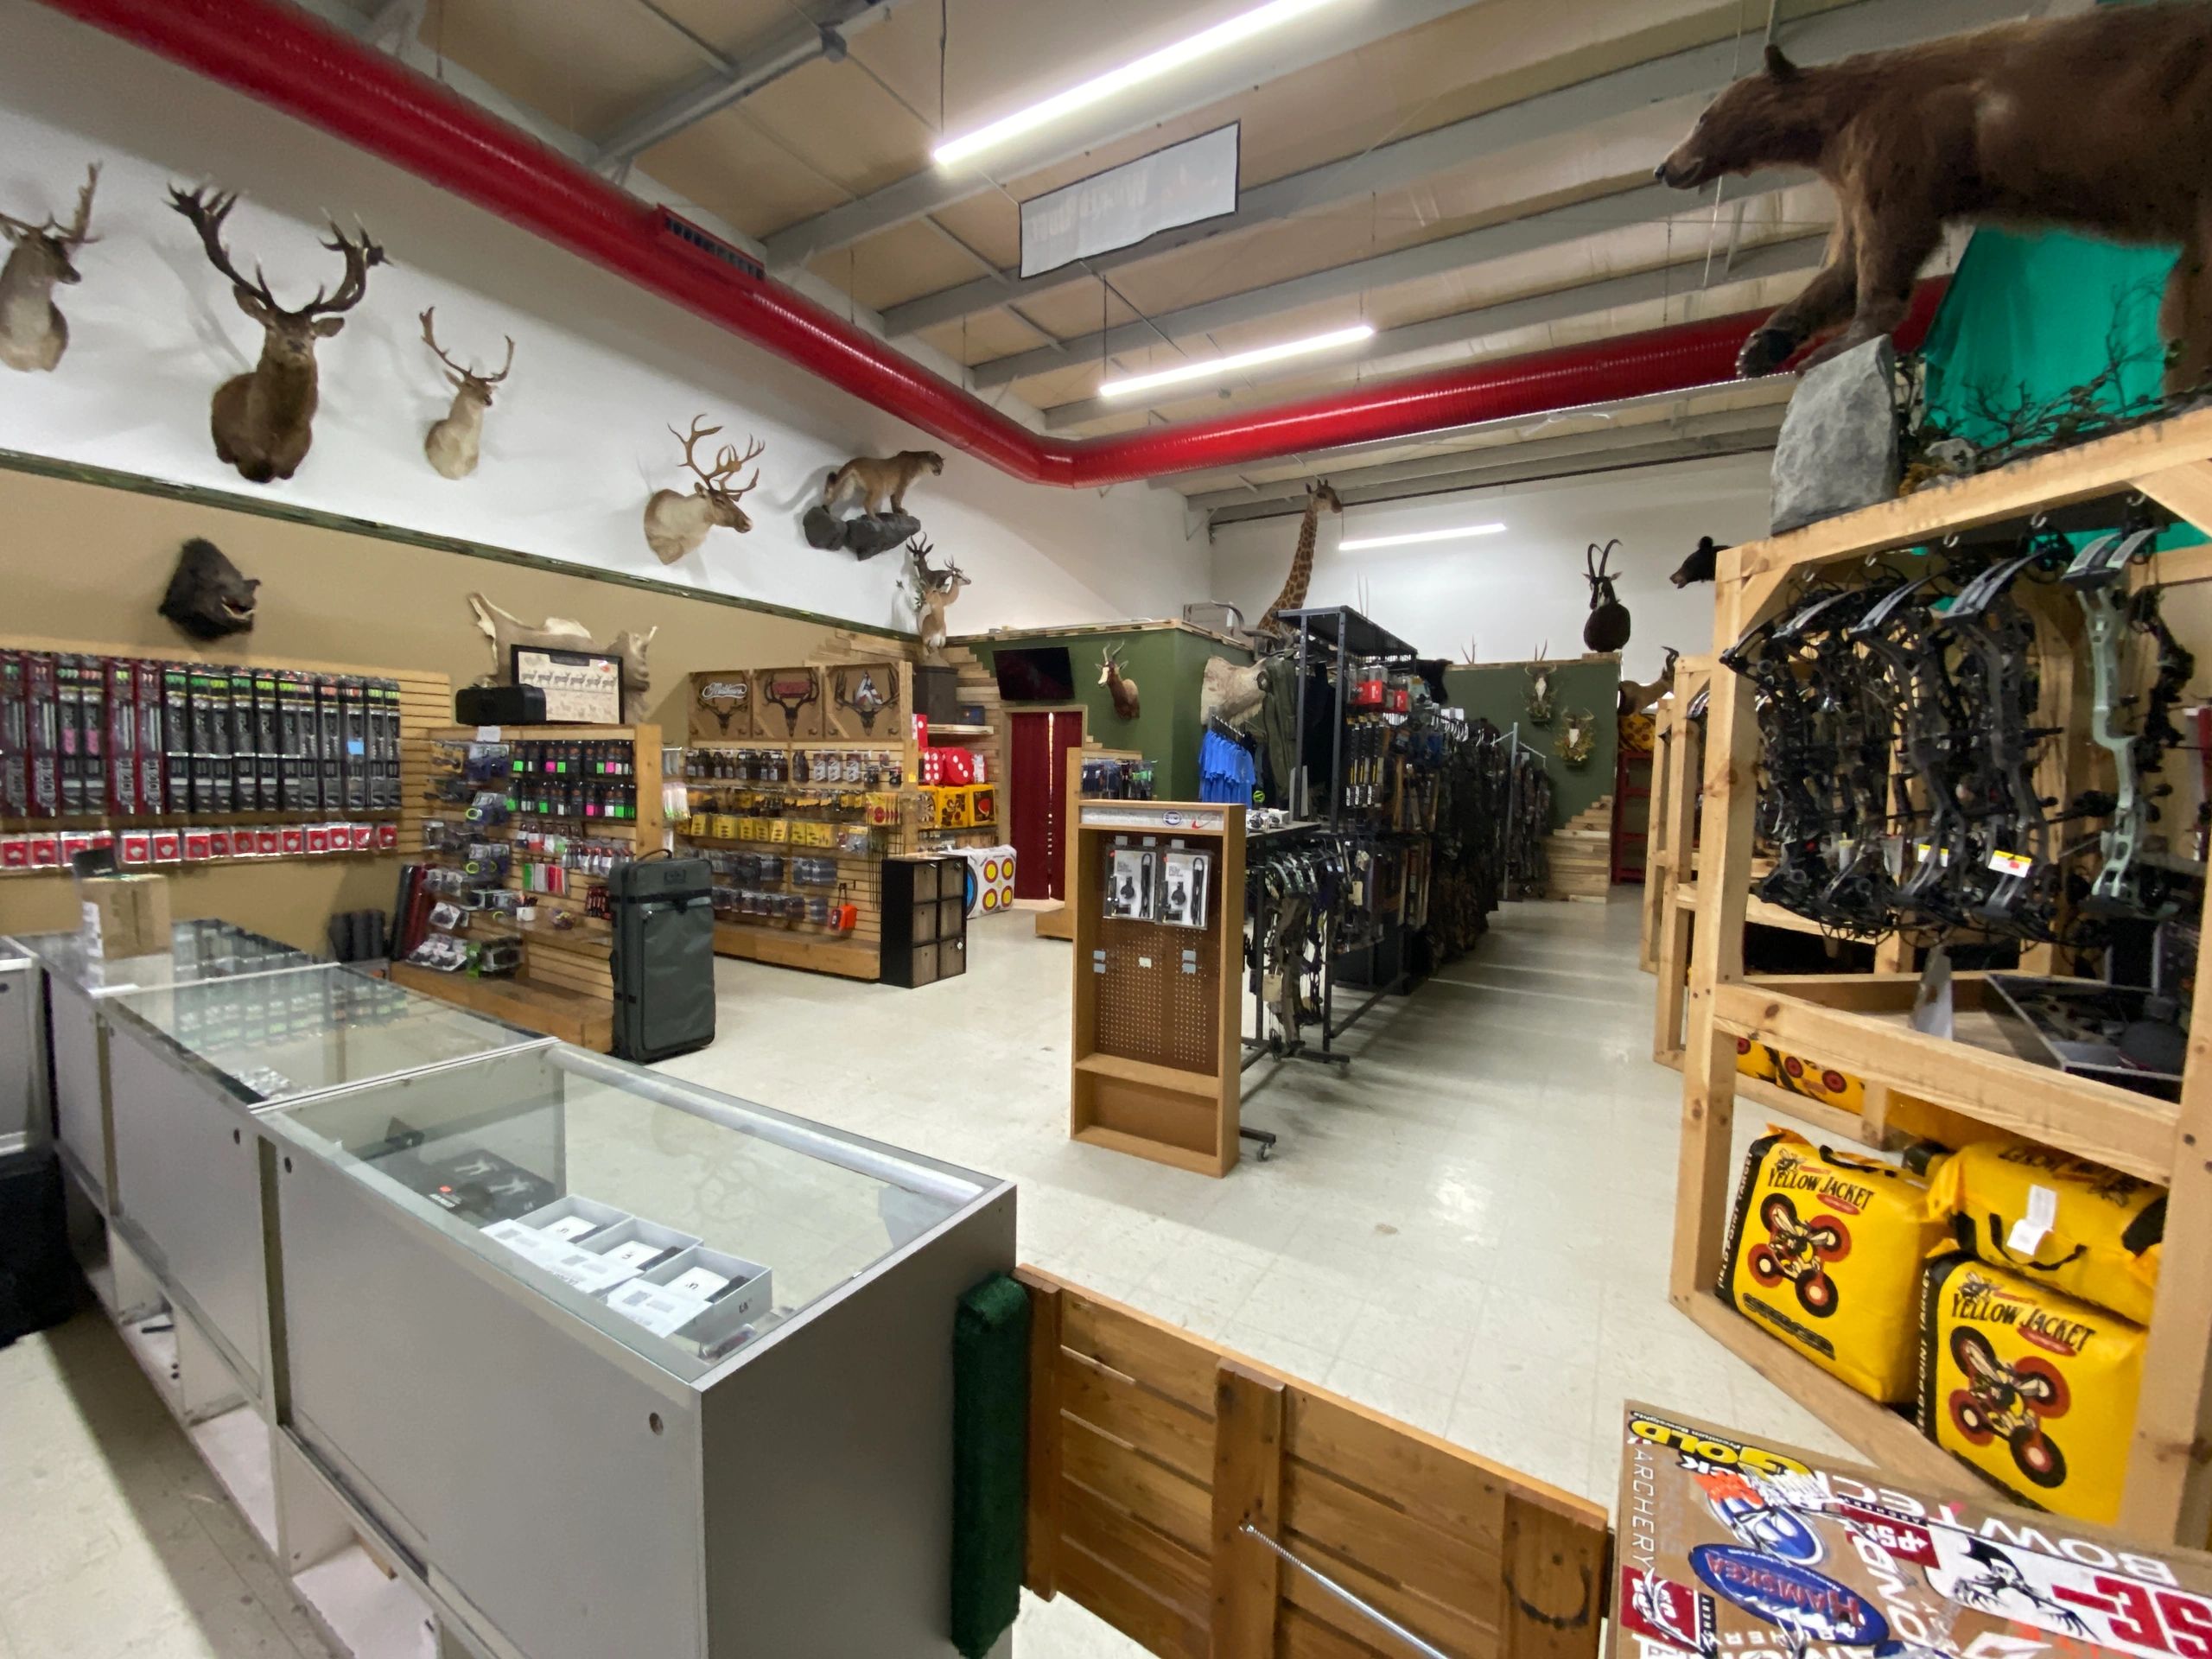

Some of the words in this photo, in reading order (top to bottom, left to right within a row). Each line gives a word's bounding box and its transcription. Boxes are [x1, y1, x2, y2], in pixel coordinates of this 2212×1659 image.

[1768, 1167, 1821, 1191] YELLOW
[1819, 1176, 1875, 1210] JACKET
[1951, 1294, 2024, 1325] YELLOW
[2019, 1308, 2097, 1352] JACKET
[1630, 1420, 1814, 1480] GOLD
[1691, 1430, 1741, 1451] Premium
[1631, 1449, 1655, 1571] ARCHERY
[1705, 1553, 1863, 1626] HAMSKEA
